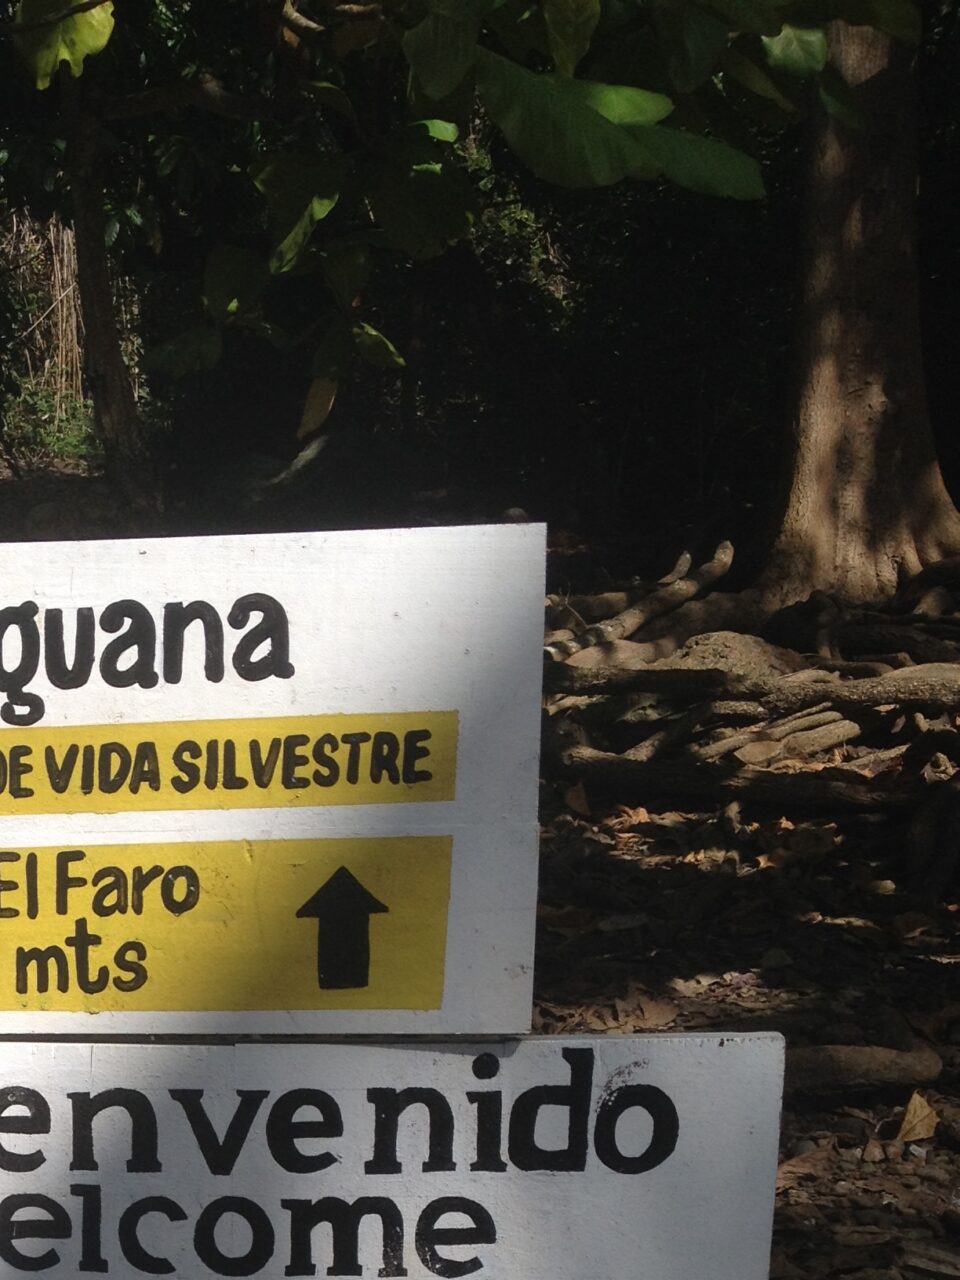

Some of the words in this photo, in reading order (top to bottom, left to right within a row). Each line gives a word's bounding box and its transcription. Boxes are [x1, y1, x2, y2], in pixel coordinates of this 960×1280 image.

[46, 738, 160, 794] VIDA
[172, 728, 432, 792] SILVESTRE
[56, 849, 199, 917] Faro
[15, 918, 148, 995] mts
